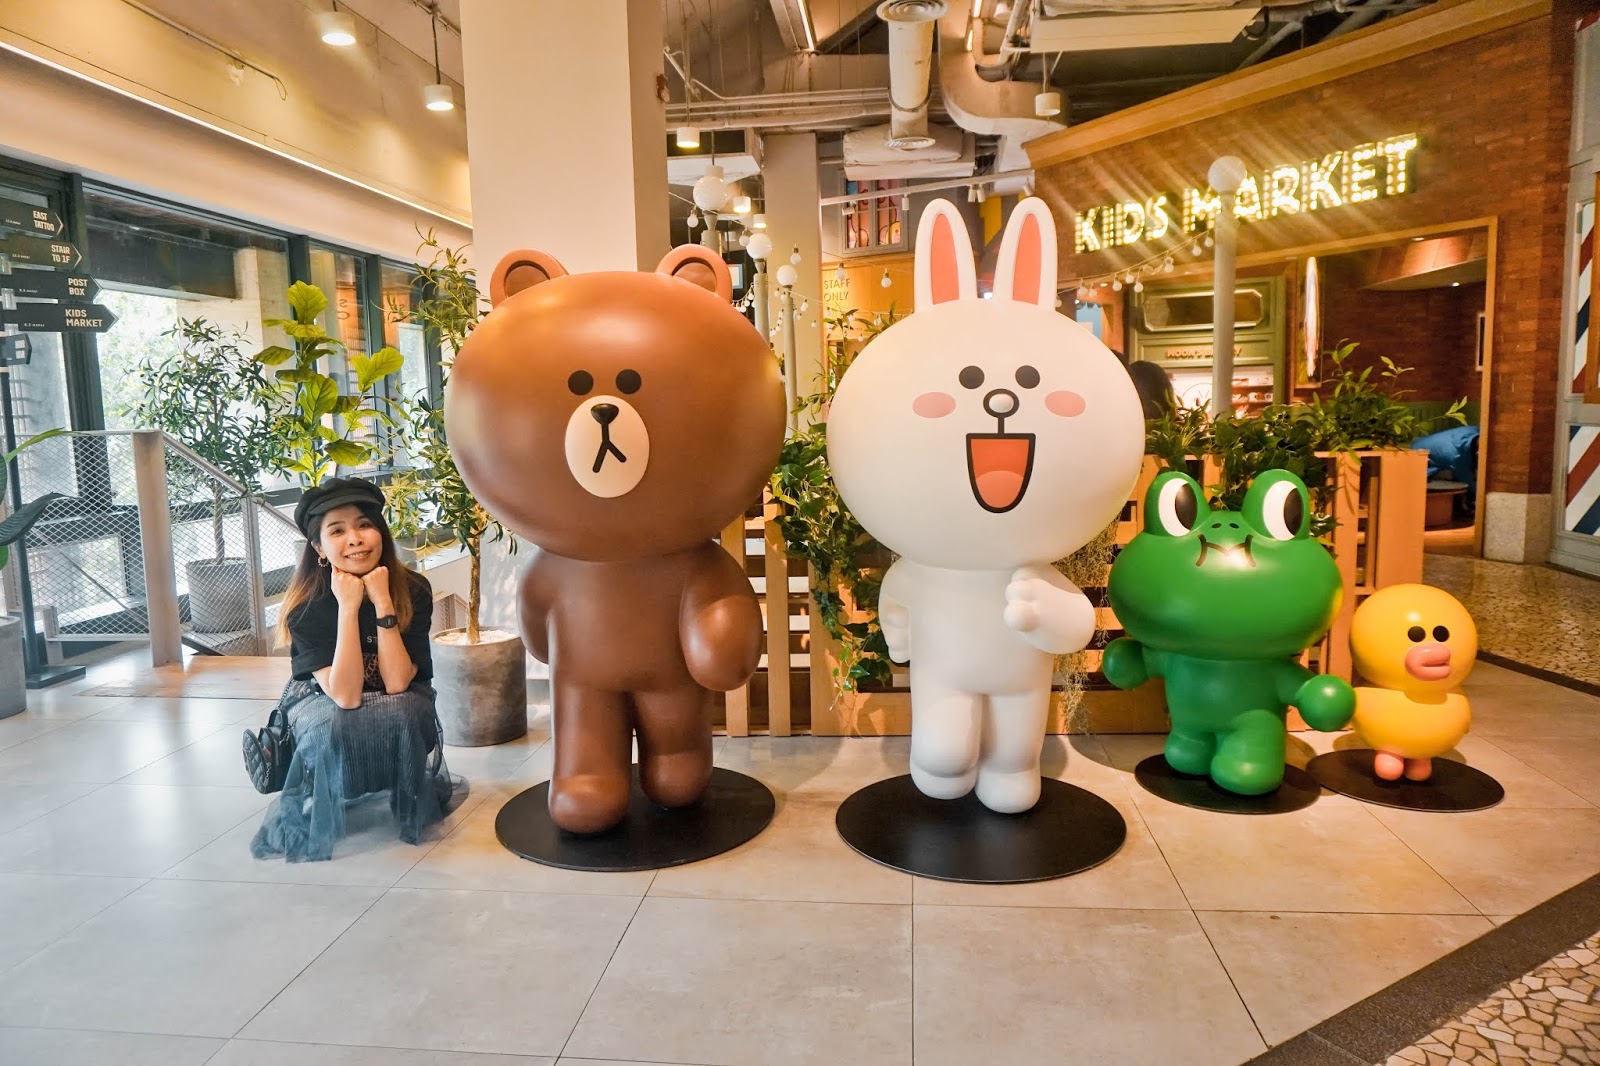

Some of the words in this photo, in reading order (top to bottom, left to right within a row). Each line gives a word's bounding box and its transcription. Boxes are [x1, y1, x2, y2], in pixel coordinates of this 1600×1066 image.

[1074, 195, 1169, 254] KIDS
[1182, 132, 1418, 234] MARKET
[33, 210, 47, 220] EAST
[33, 220, 55, 231] TATTOO
[51, 244, 70, 254] STAIR
[52, 254, 61, 262] TO
[62, 255, 70, 263] 1F
[68, 278, 88, 286] POST
[824, 278, 850, 289] STAFF
[69, 288, 85, 296] BOX
[824, 291, 849, 302] ONLY
[65, 309, 87, 318] KIDS
[66, 319, 103, 327] MARKET
